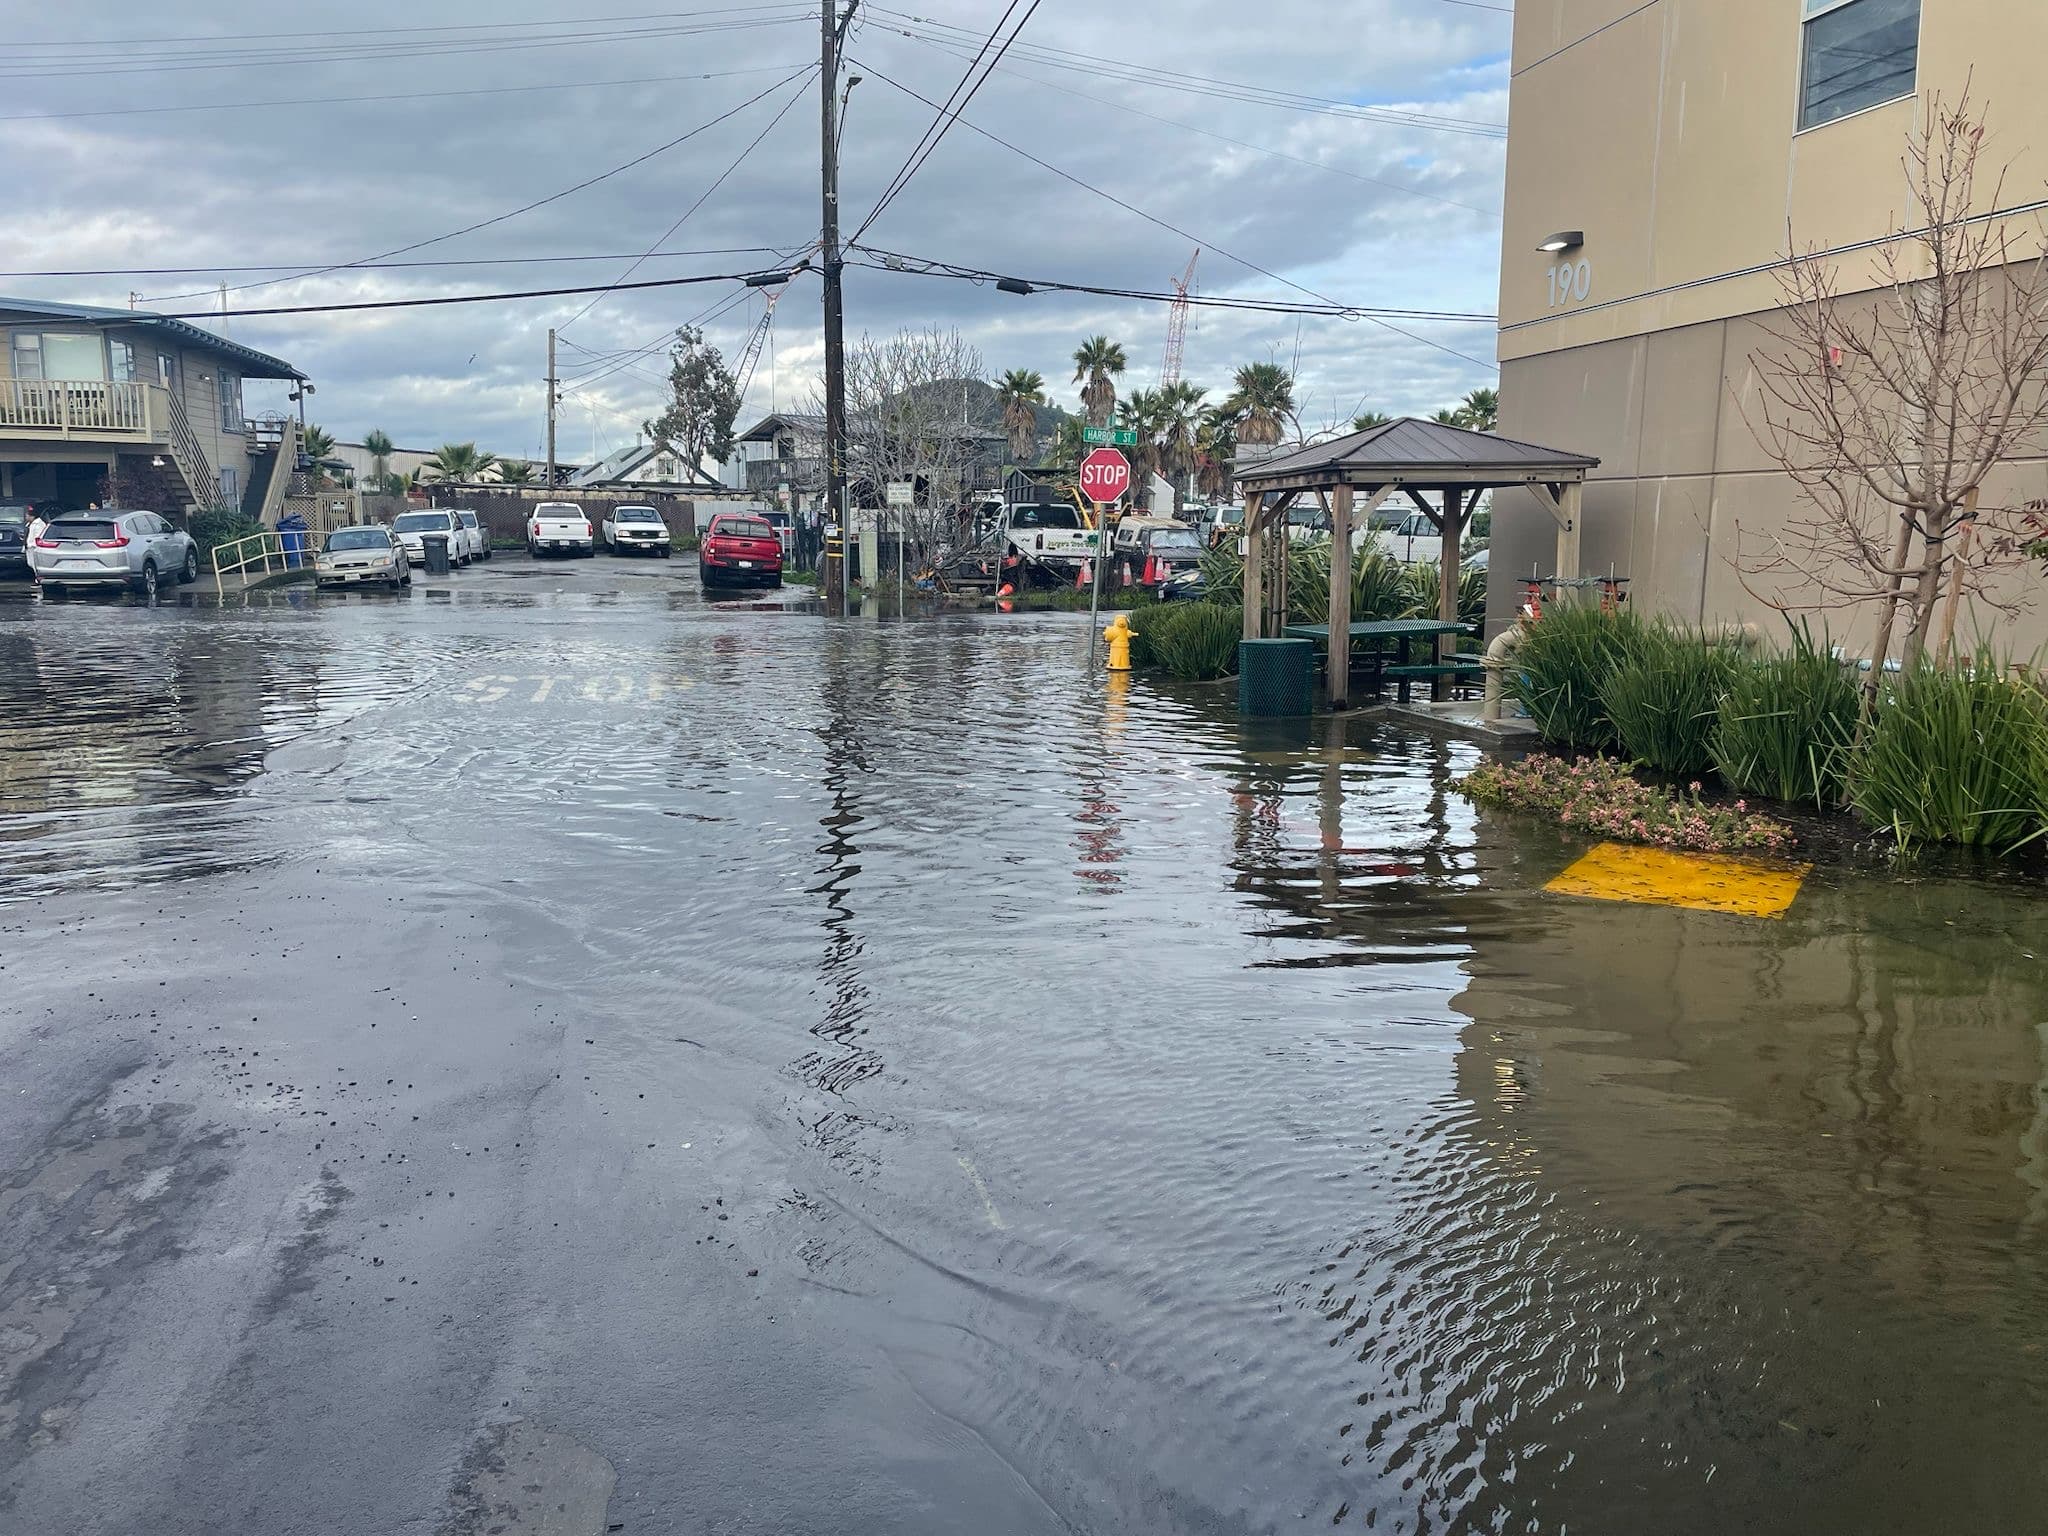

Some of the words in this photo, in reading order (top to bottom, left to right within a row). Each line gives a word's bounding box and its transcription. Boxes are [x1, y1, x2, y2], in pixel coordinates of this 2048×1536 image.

[1547, 257, 1591, 306] 190
[1087, 429, 1116, 442] HARBOR
[1083, 465, 1126, 485] STOP
